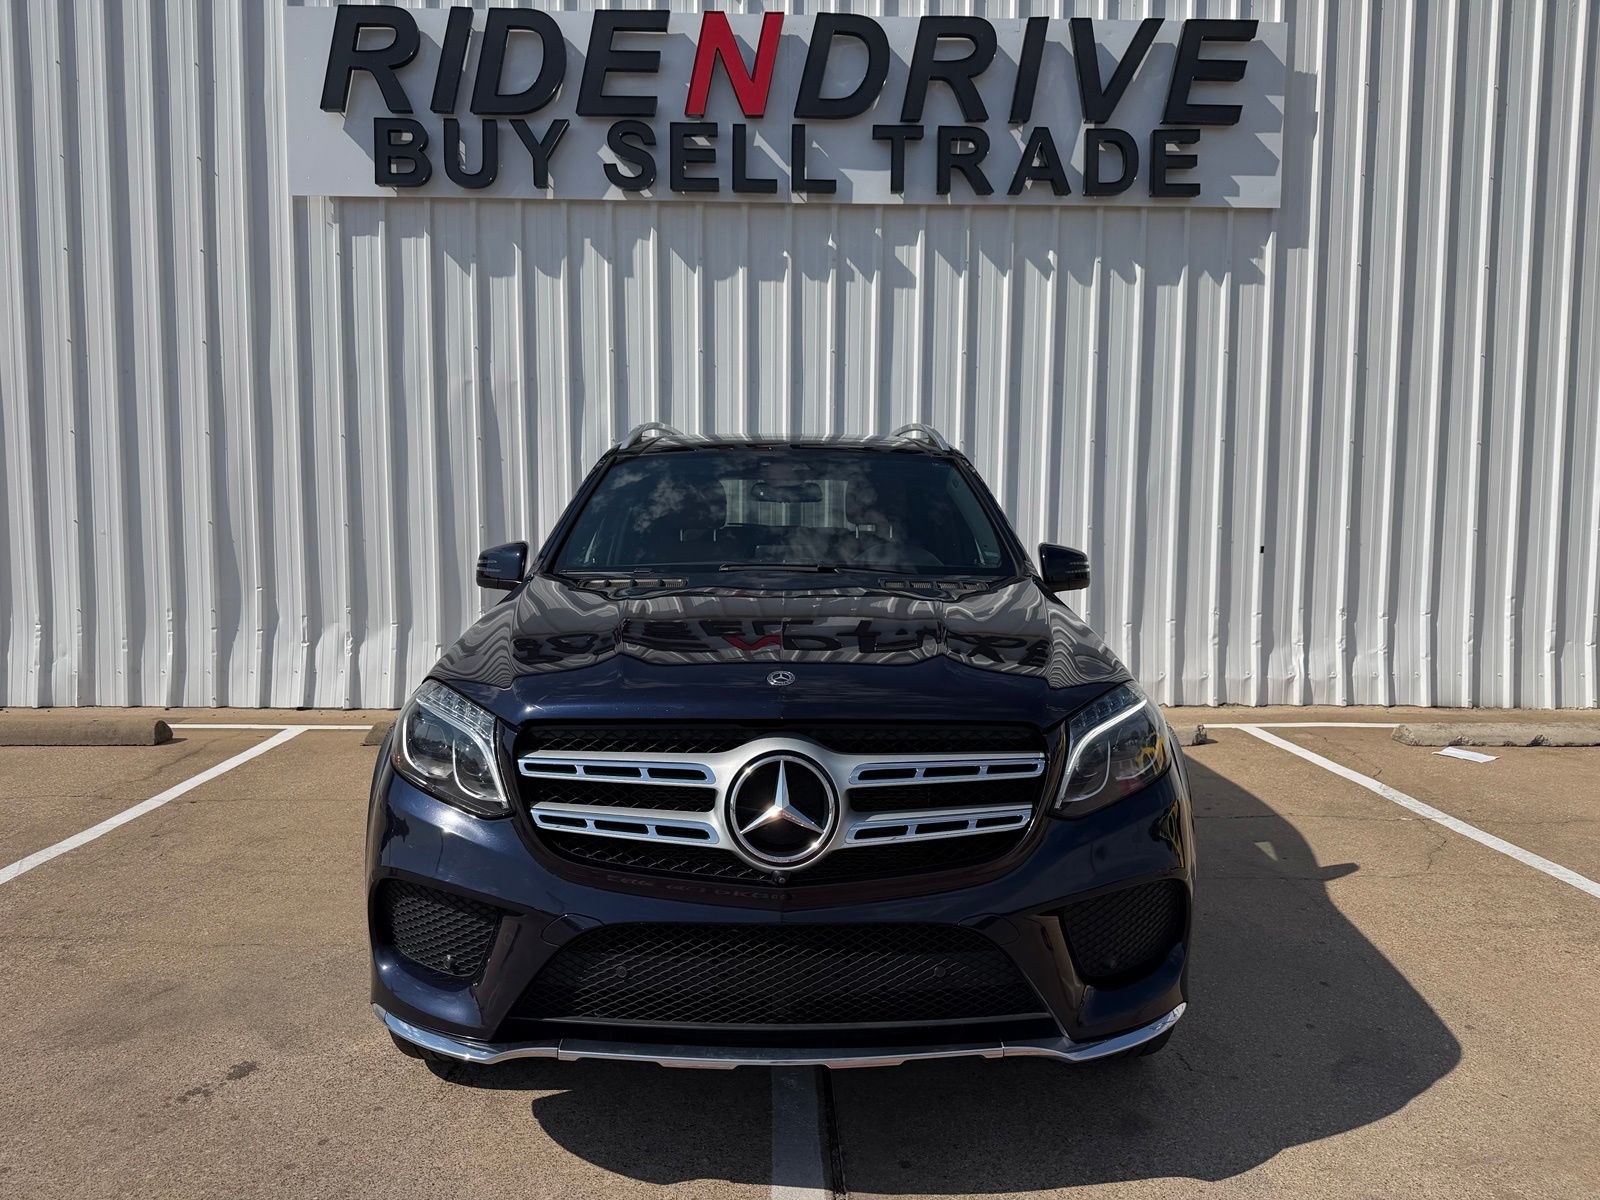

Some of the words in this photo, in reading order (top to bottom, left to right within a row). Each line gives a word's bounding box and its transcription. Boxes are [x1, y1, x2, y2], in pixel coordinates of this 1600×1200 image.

[320, 4, 1258, 125] RIDENDRIVE
[373, 117, 570, 189] BUY
[602, 119, 837, 194] SELL
[872, 124, 1201, 198] TRADE
